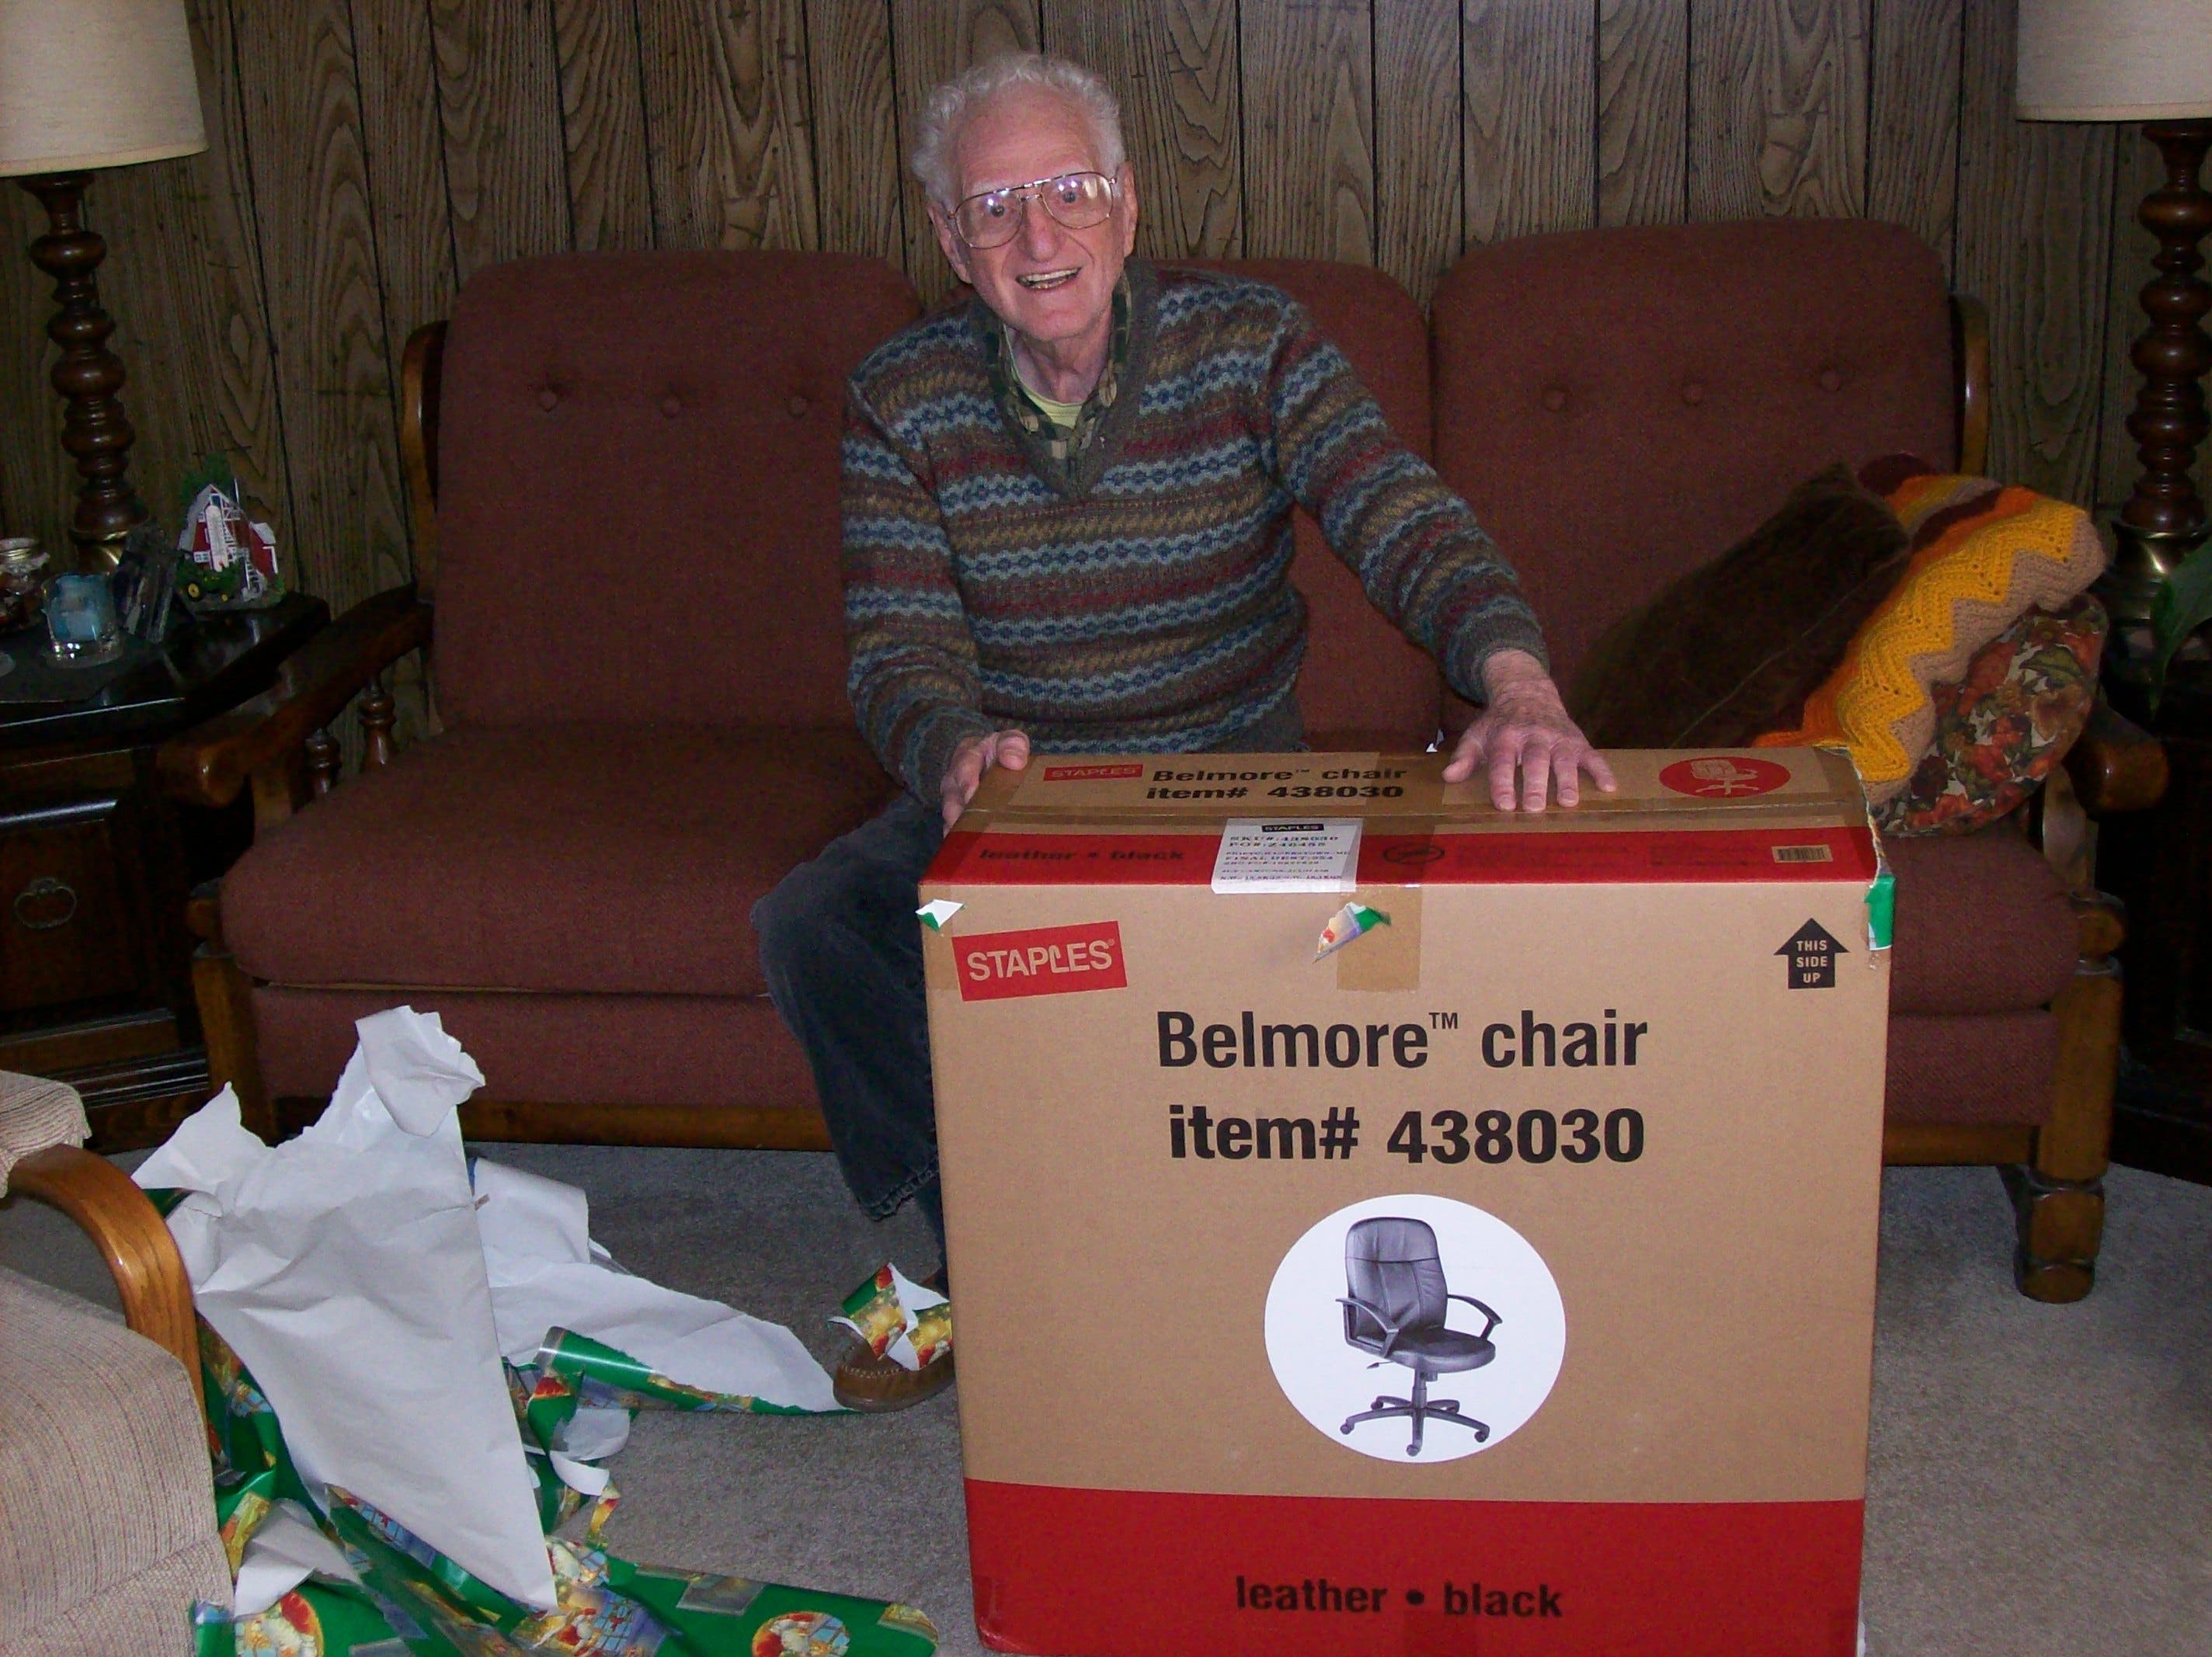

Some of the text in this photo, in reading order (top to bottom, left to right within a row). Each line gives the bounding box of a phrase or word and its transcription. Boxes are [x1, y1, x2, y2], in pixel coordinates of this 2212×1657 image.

[1052, 767, 1136, 778] STAPLES
[1321, 767, 1407, 780] chair
[1146, 785, 1404, 799] item# 438030
[1111, 849, 1183, 860] black
[1796, 940, 1828, 952] THIS
[1796, 956, 1828, 968] SIDE
[1802, 972, 1821, 984] UP
[1481, 1009, 1648, 1068] chair
[1168, 1104, 1644, 1164] item# 438030
[1235, 1575, 1564, 1618] leather black
